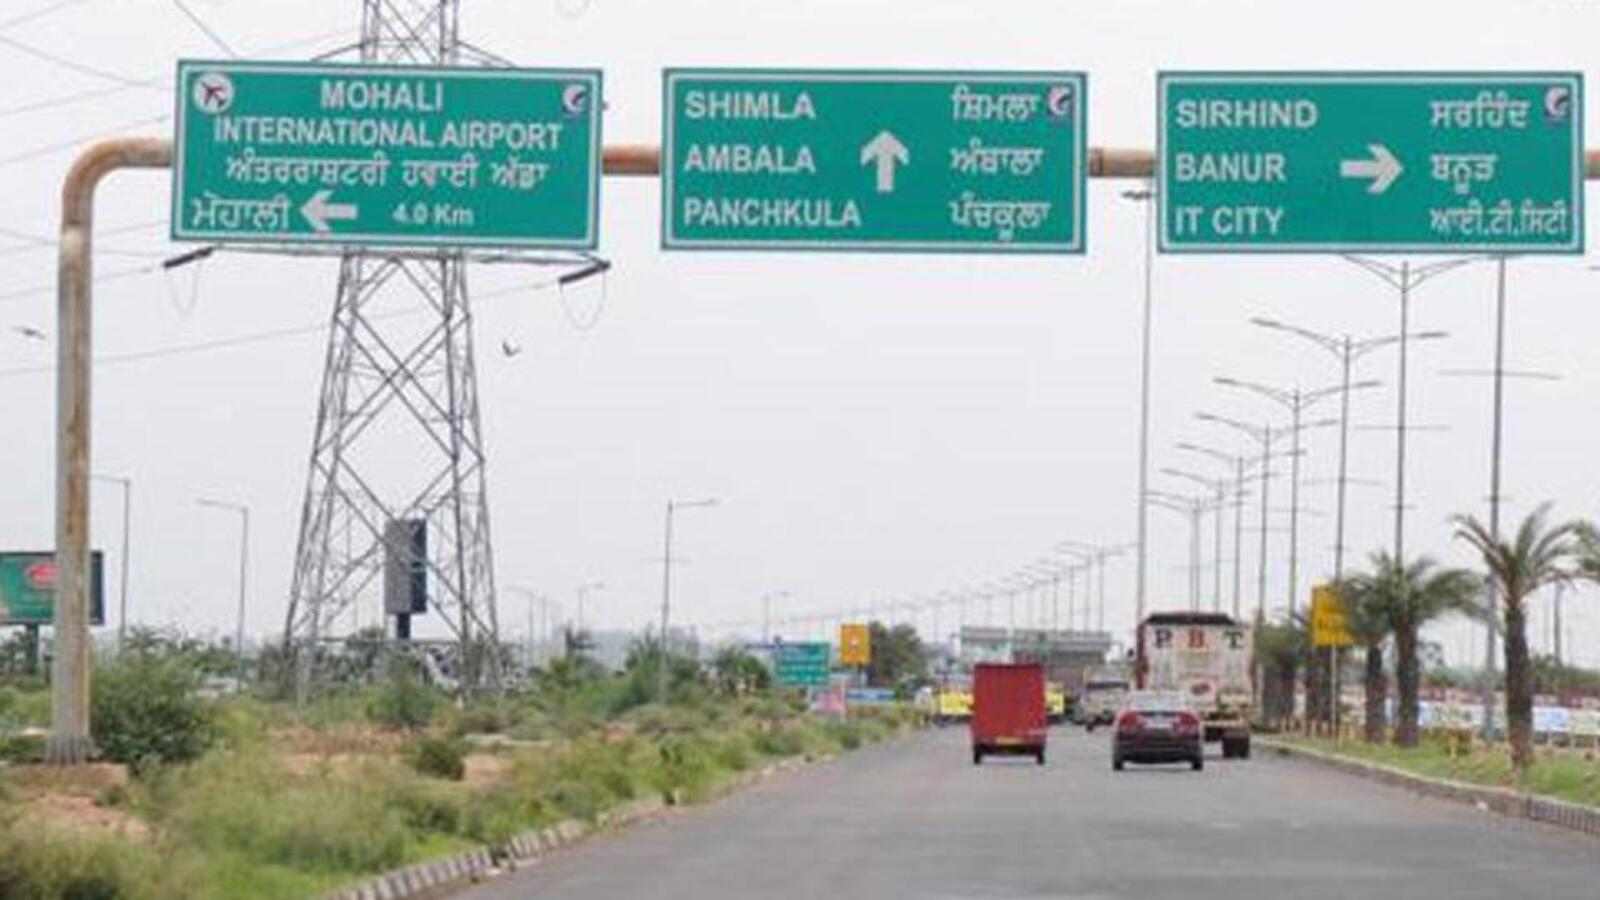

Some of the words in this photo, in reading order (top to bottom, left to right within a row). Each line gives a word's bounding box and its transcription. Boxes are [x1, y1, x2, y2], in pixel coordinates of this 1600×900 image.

[320, 80, 444, 110] MOHALI
[684, 92, 817, 119] SHIMLA
[1175, 100, 1318, 128] SIRHIND
[1430, 90, 1531, 129] ਸਰਹਿੰਦ
[214, 117, 434, 148] INTERNATIONAL
[440, 121, 562, 150] AIRPORT
[683, 145, 816, 173] AMBALA
[950, 136, 1044, 175] ਅੰਬਾਲਾ
[1175, 154, 1287, 182] BANUR
[393, 204, 429, 225] 4.0
[433, 204, 475, 226] Km
[683, 199, 862, 227] PANCHKULA
[1175, 207, 1202, 235] IT
[1212, 206, 1285, 235] CITY
